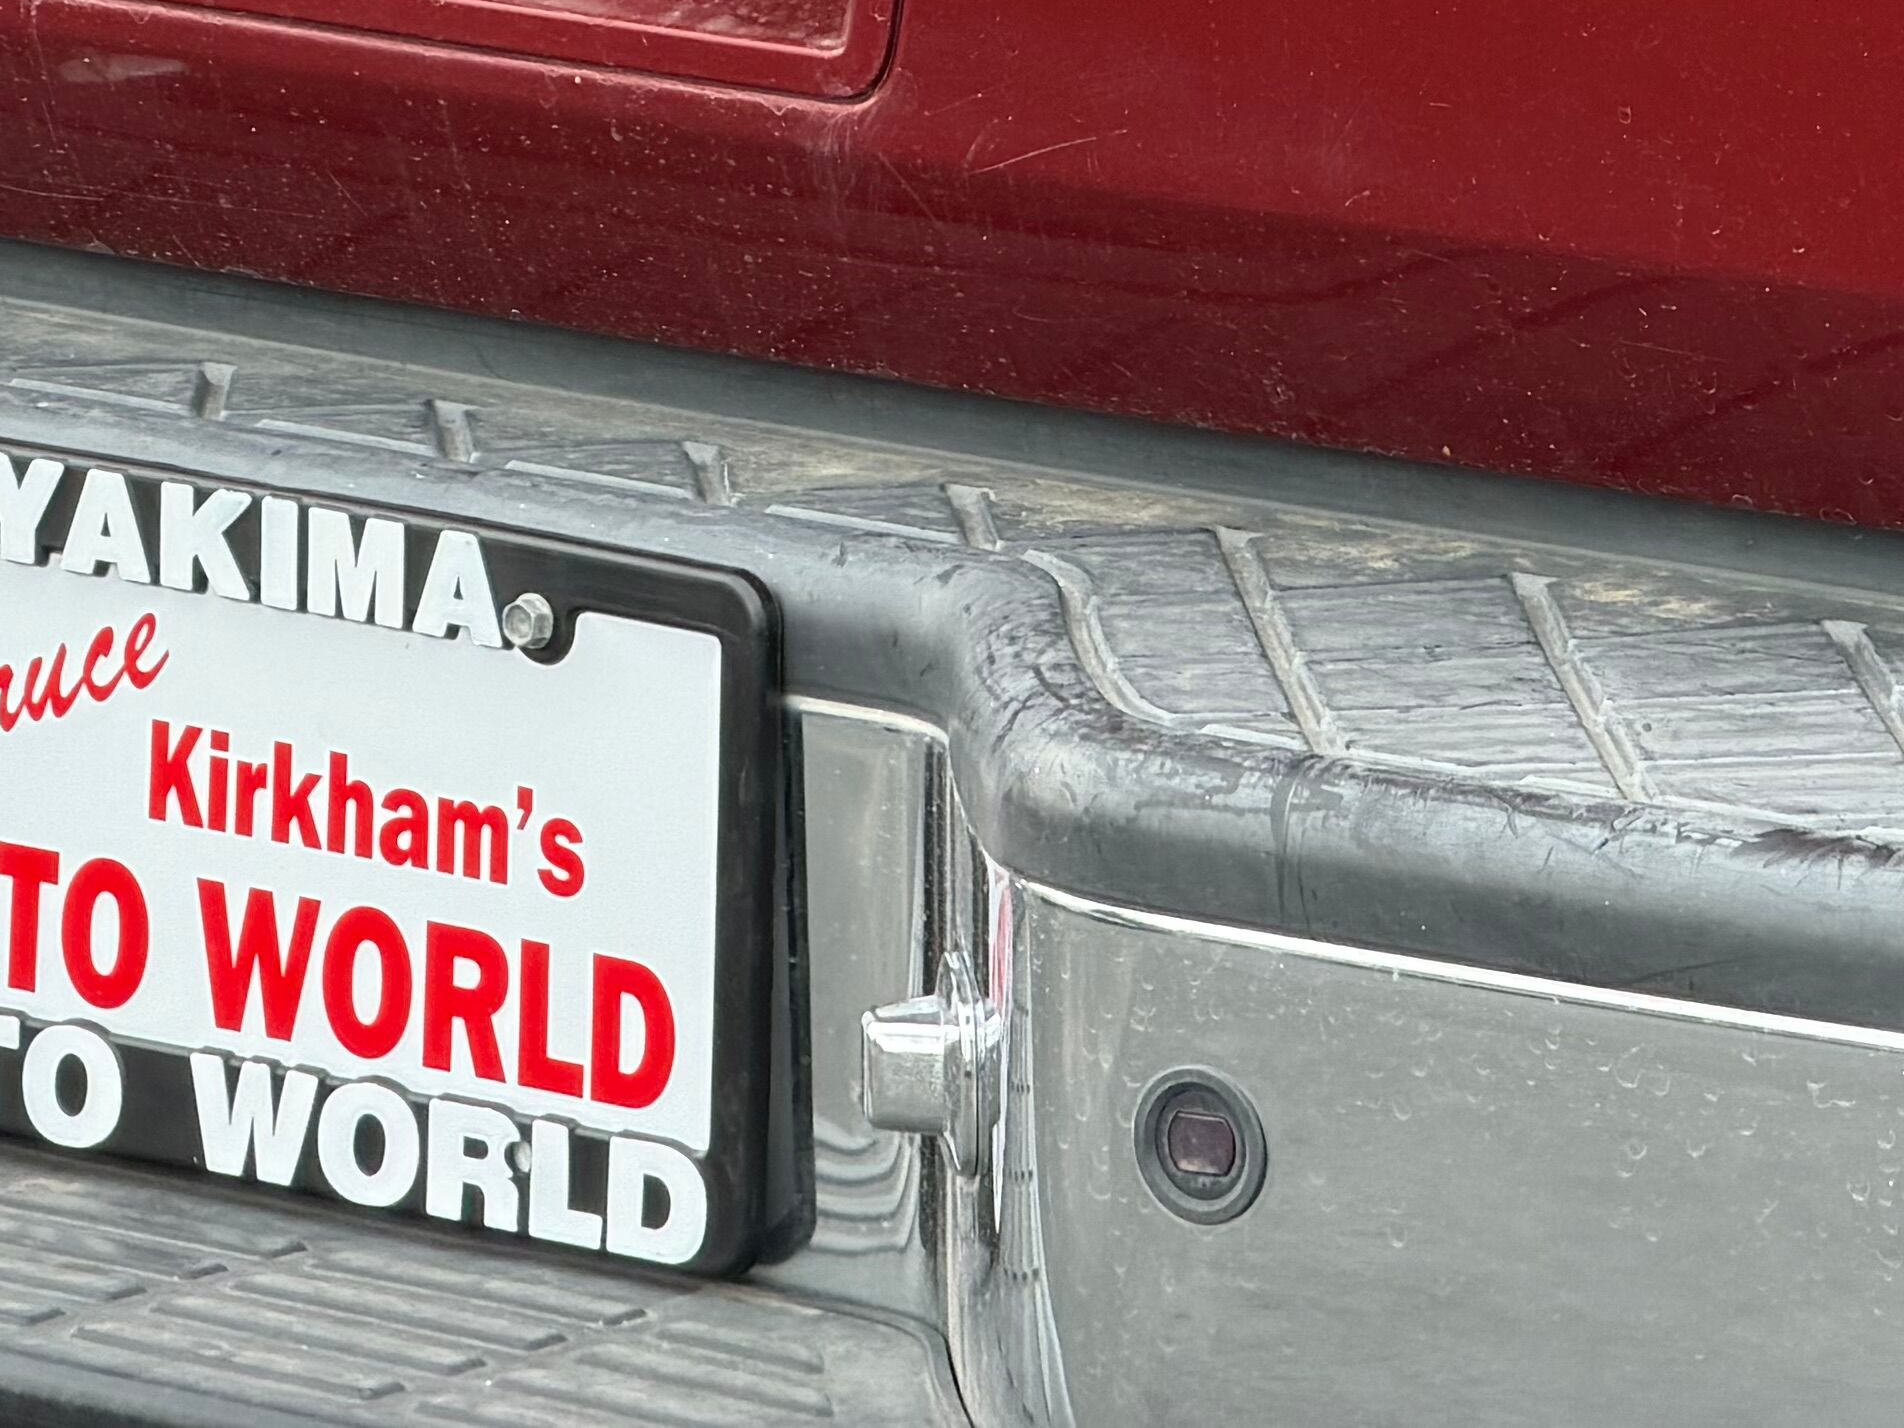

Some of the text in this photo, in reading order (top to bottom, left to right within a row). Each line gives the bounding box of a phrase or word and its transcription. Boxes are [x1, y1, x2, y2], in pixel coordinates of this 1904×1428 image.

[148, 720, 585, 898] Kirkham's
[198, 879, 676, 1109] WORLD
[190, 1052, 707, 1266] WORLD
